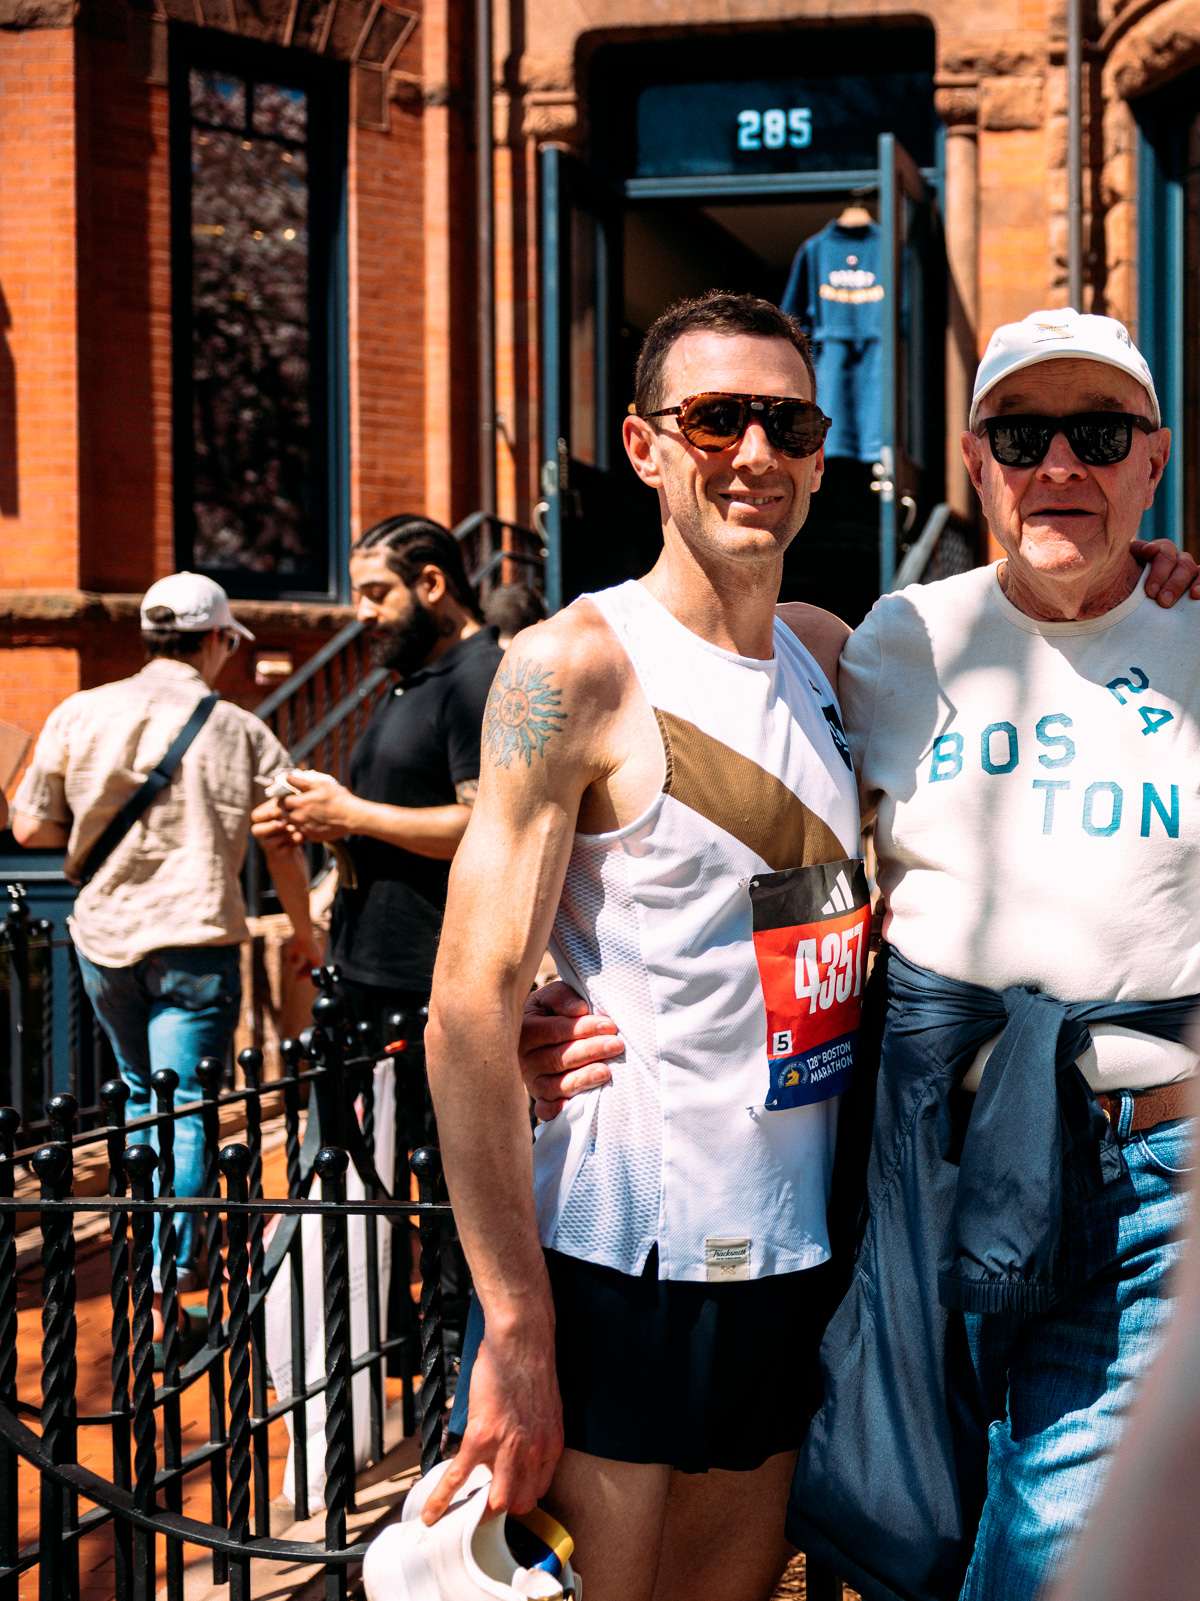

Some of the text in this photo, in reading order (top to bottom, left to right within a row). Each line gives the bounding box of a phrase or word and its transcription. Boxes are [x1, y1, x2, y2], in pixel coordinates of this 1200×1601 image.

[738, 108, 812, 150] 285
[1106, 667, 1174, 736] 24
[928, 713, 1076, 783] BOS
[1032, 779, 1180, 838] TON
[795, 921, 864, 1015] 4357
[777, 1034, 789, 1051] 5
[822, 1040, 851, 1063] BOSTON
[811, 1054, 853, 1083] MARATHON
